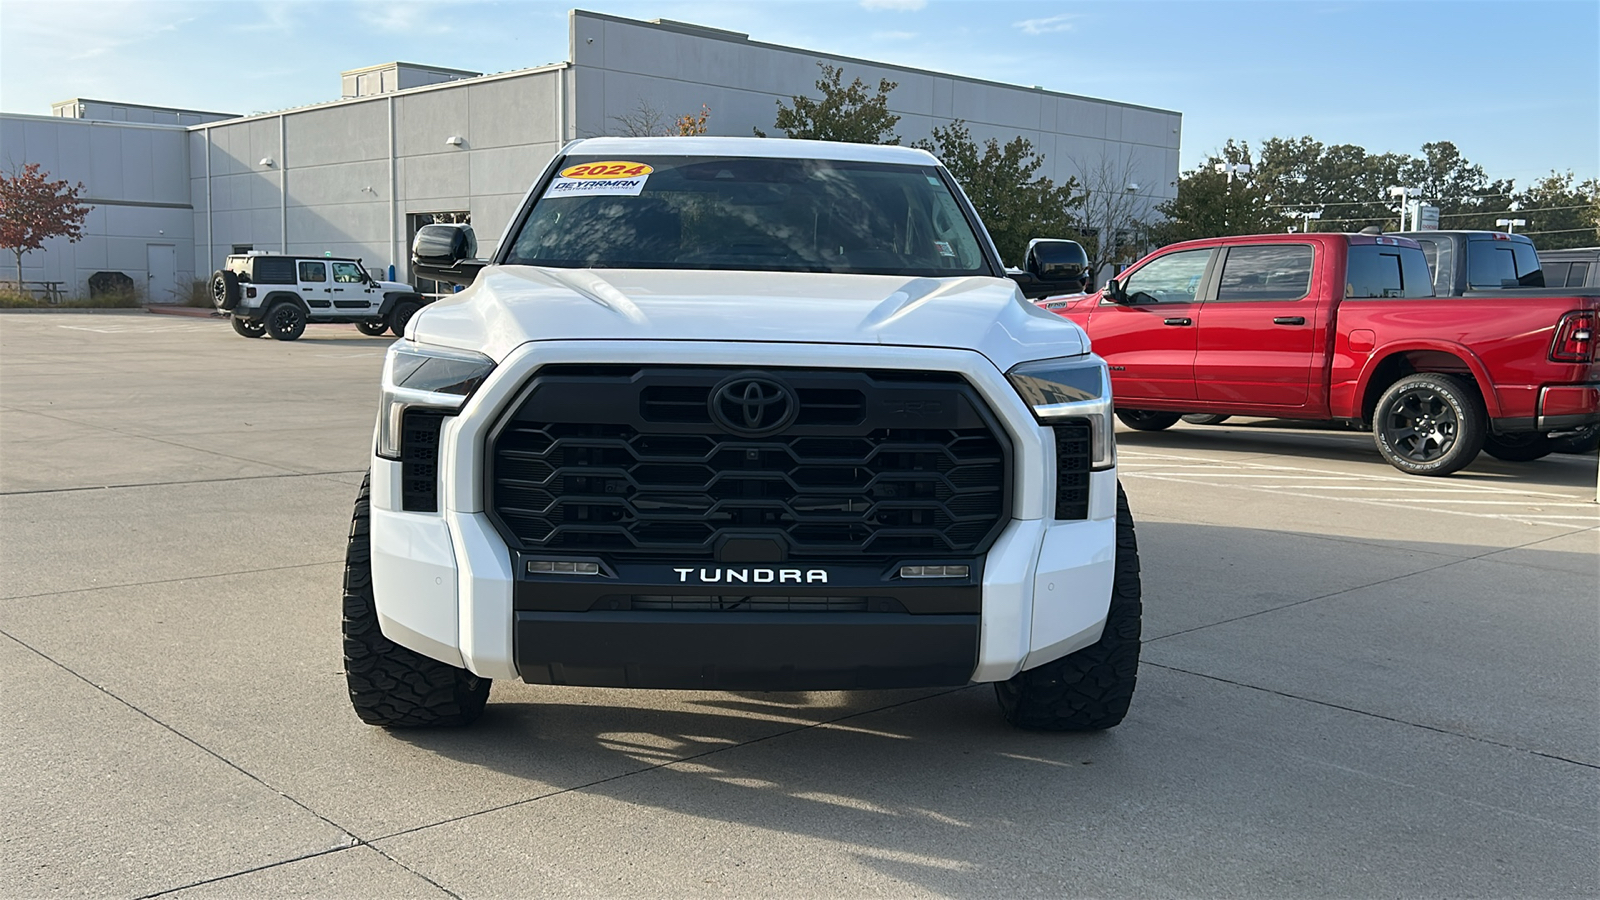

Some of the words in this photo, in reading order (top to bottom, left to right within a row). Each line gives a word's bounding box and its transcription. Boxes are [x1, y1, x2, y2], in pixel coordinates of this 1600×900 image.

[568, 165, 646, 177] 2024
[554, 180, 640, 190] DEYARMAN
[673, 568, 828, 583] TUNDRA
